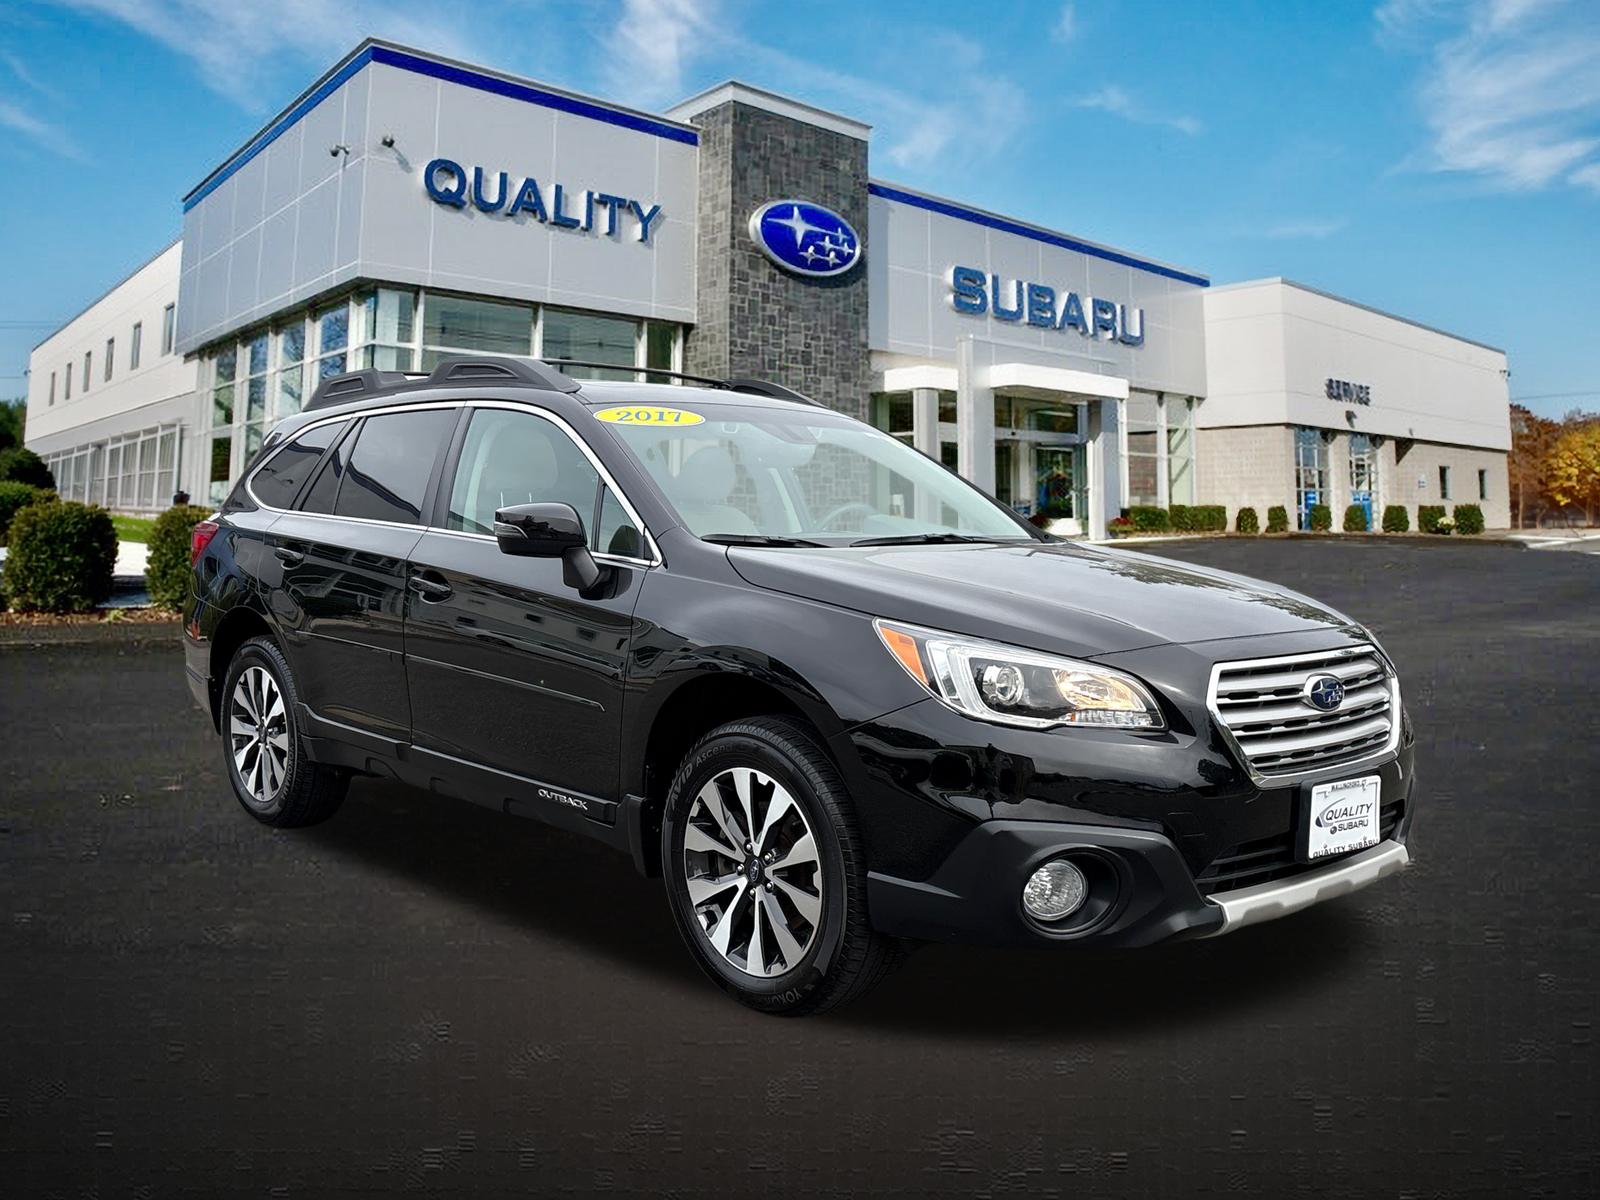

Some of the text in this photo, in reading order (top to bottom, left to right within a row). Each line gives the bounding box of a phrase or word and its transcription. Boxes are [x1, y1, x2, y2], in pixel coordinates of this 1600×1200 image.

[424, 158, 661, 243] QUALITY
[950, 264, 1146, 346] SUBARU
[616, 410, 682, 422] 2017
[538, 788, 588, 810] OUTBACK
[1325, 803, 1373, 821] QUALITY
[1337, 819, 1368, 831] SUBARU
[1313, 838, 1378, 857] QUALITY SUBARU
